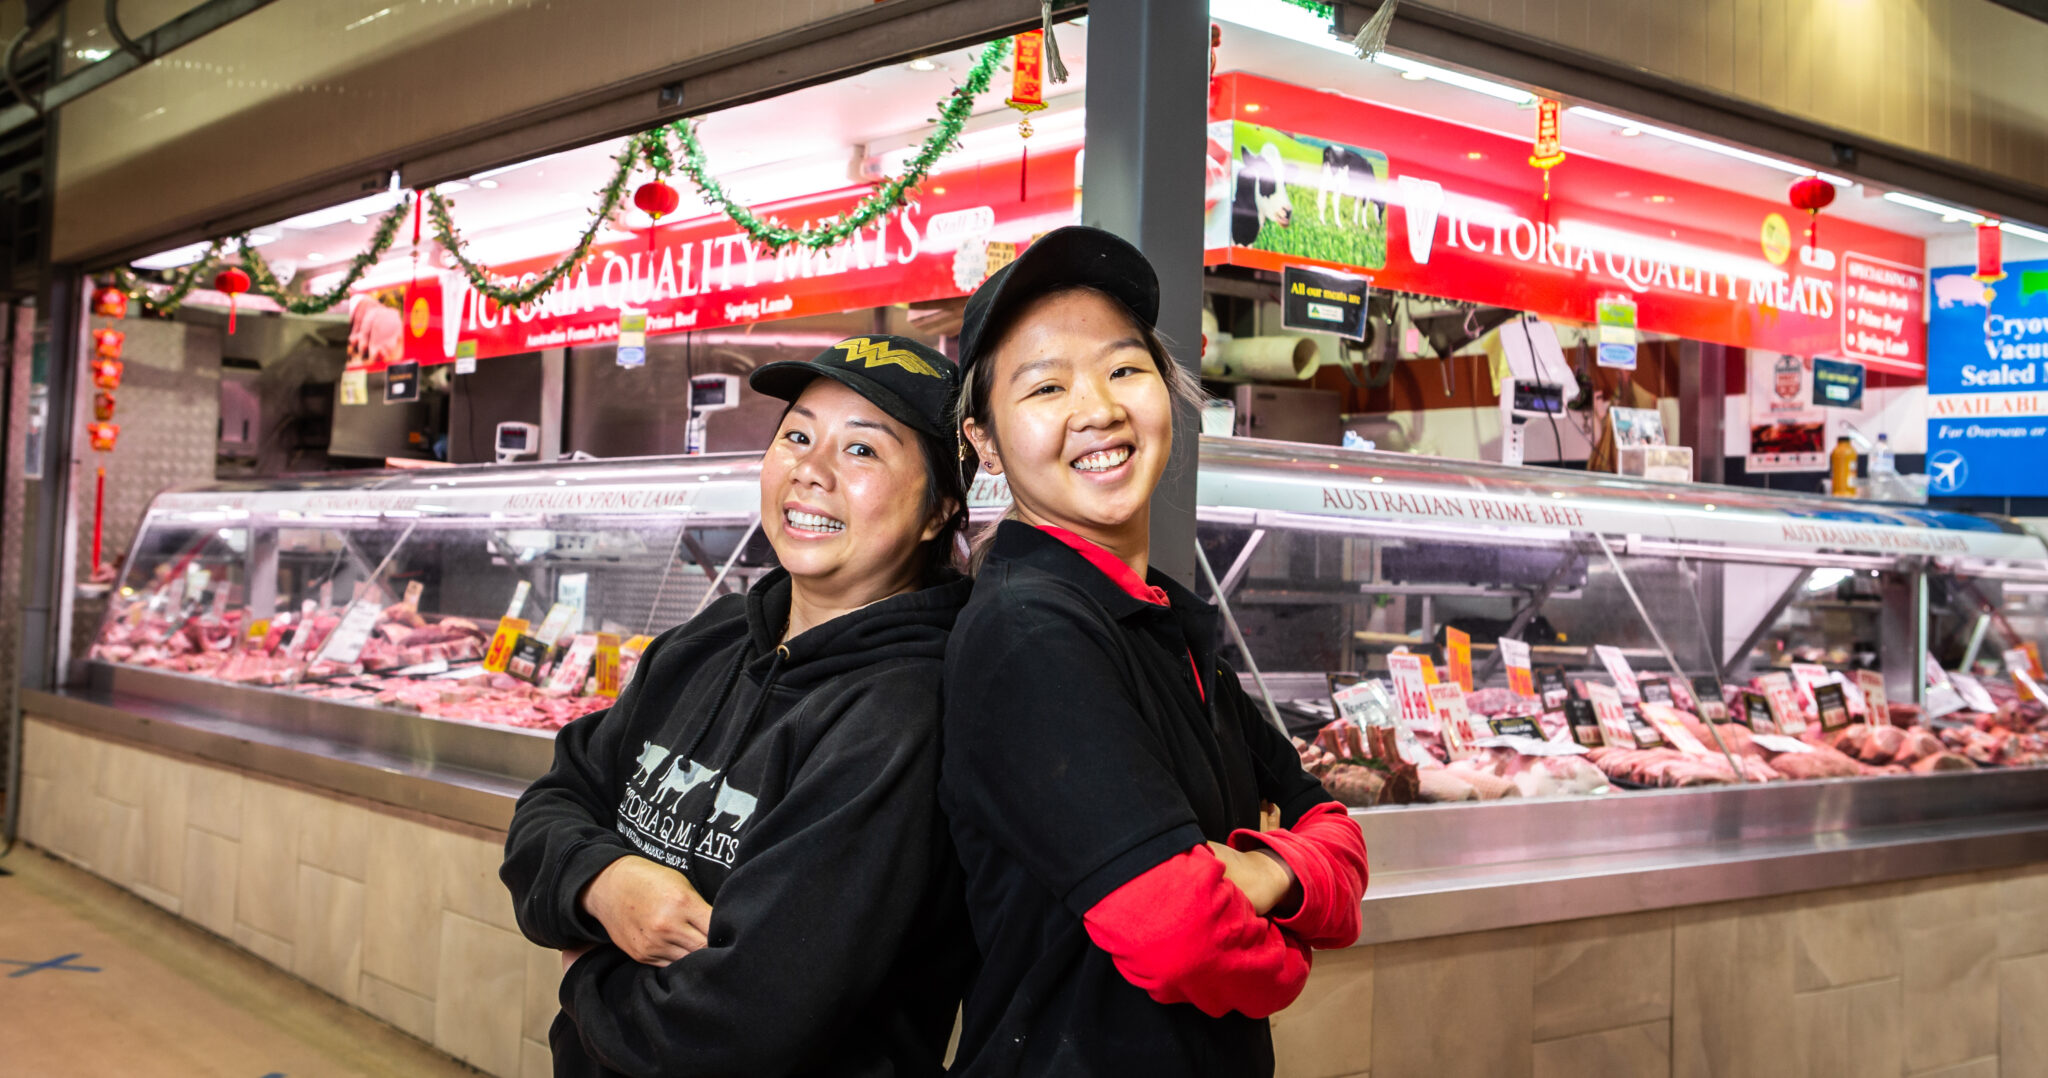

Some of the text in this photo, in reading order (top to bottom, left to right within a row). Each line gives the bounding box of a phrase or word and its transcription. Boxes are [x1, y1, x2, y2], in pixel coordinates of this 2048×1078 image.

[1398, 174, 1599, 275] VICTORIA
[1604, 238, 1743, 300] QUALITY
[1748, 261, 1834, 320] MEATS
[600, 232, 762, 316] QUALITY
[1290, 282, 1306, 296] All
[1306, 286, 1323, 298] our
[1323, 289, 1348, 302] meats
[675, 308, 698, 327] Beef
[723, 300, 759, 323] Spring
[760, 294, 793, 317] Lamb
[1857, 307, 1904, 337] Prime Beef
[1961, 363, 2036, 386] Sealed
[1938, 425, 1964, 439] For
[1966, 424, 2028, 438] Overseas
[505, 489, 688, 509] AUSTRALIAN SPRING LAMB
[1322, 487, 1585, 527] AUSTRALIAN PRIME BEEF
[1781, 524, 1875, 546] AUSTRALIAN
[659, 815, 675, 848] Q
[670, 820, 740, 864] MATS
